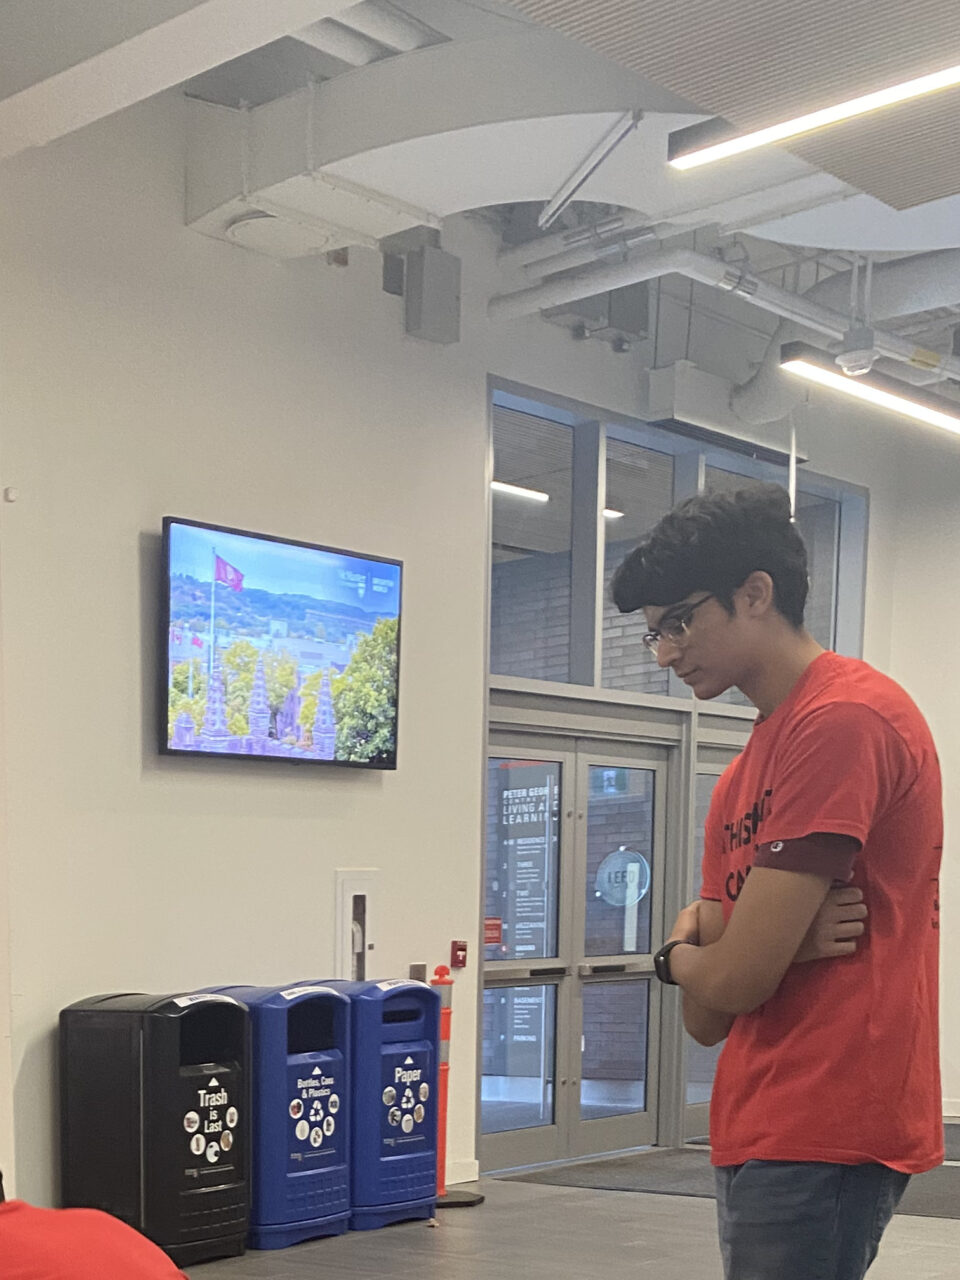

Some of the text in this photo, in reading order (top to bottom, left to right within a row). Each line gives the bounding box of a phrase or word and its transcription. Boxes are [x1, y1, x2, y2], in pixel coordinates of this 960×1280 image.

[503, 803, 535, 814] LIVING
[725, 865, 751, 902] CA
[395, 1067, 421, 1086] Paper
[197, 1088, 228, 1107] Trash
[210, 1107, 218, 1120] is
[204, 1120, 223, 1133] Last
